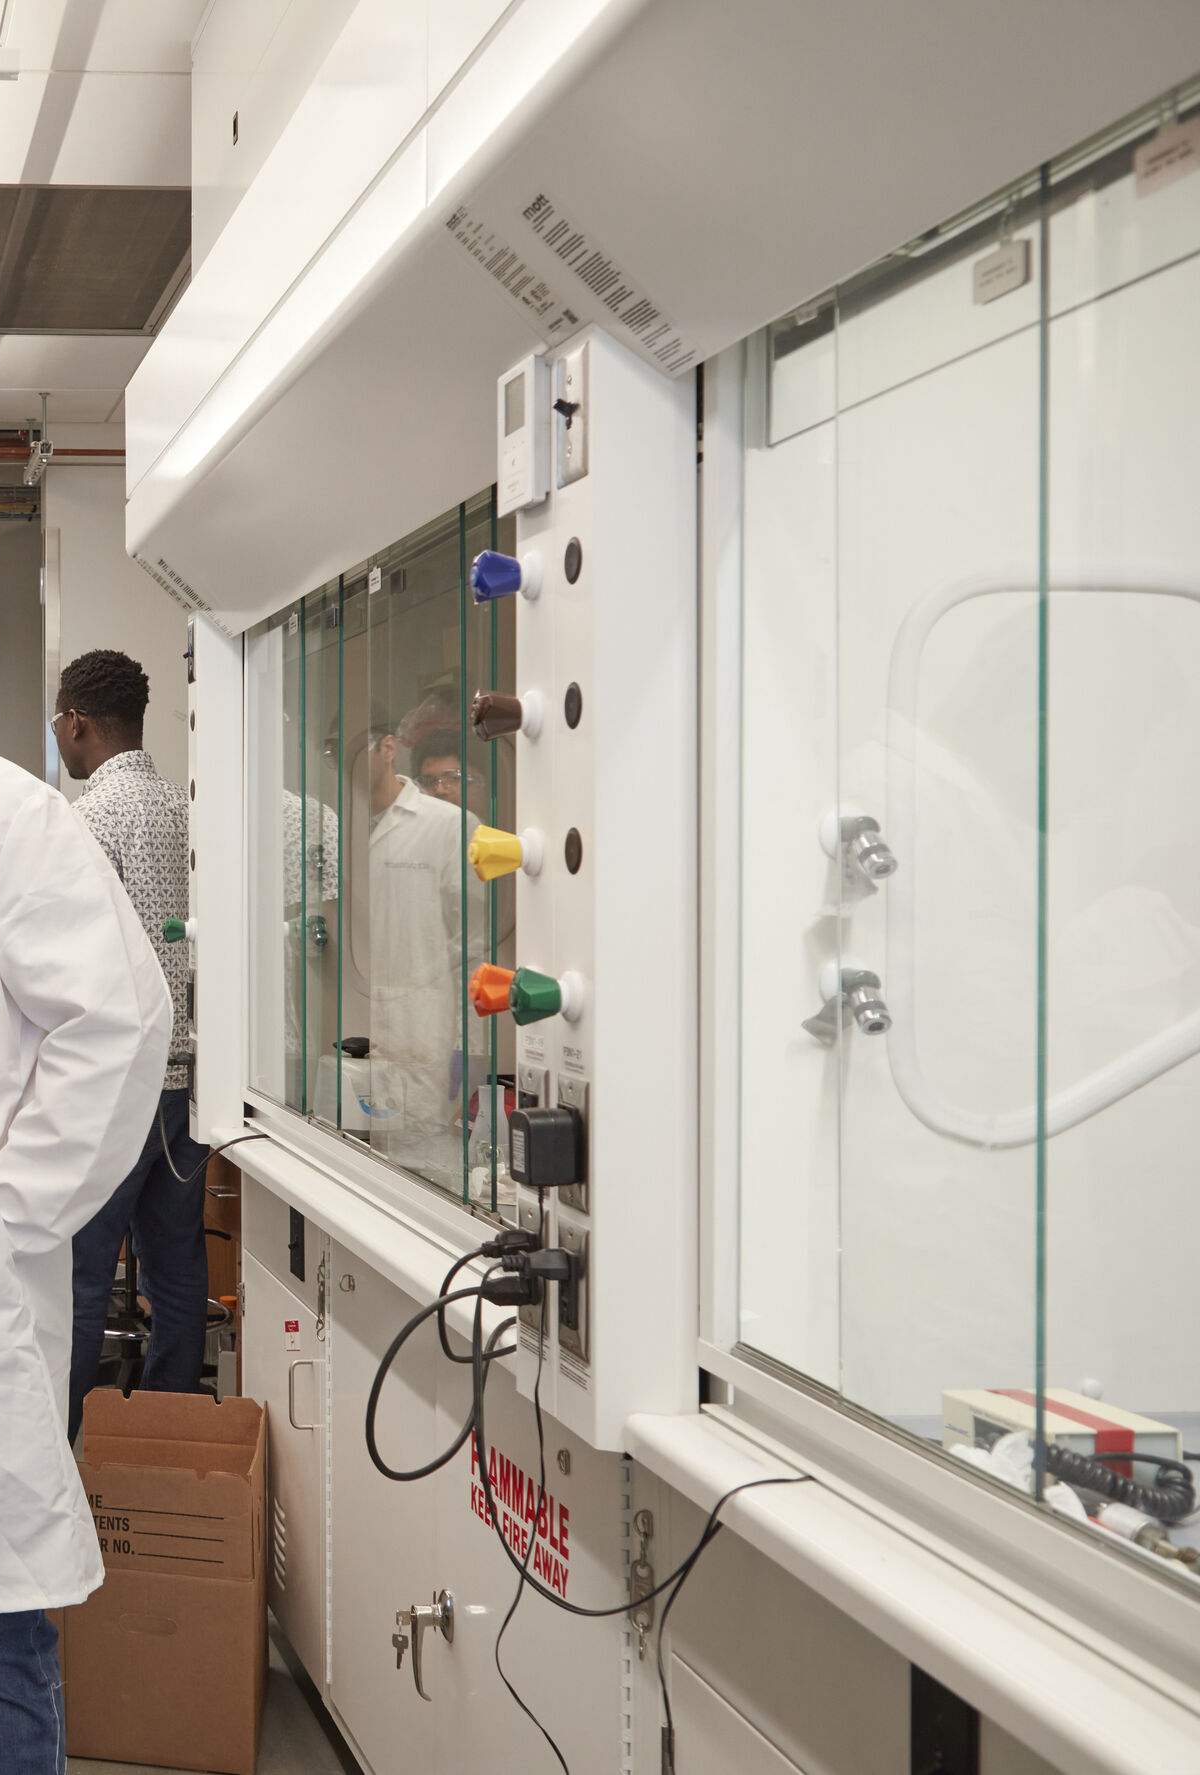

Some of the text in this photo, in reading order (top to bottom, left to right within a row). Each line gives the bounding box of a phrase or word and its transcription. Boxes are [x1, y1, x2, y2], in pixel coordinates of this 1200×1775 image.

[522, 194, 550, 220] mott
[471, 1428, 569, 1561] FAMMABLE
[113, 1539, 135, 1555] NO.
[502, 1510, 528, 1561] FIRE
[533, 1541, 569, 1599] AWAY
